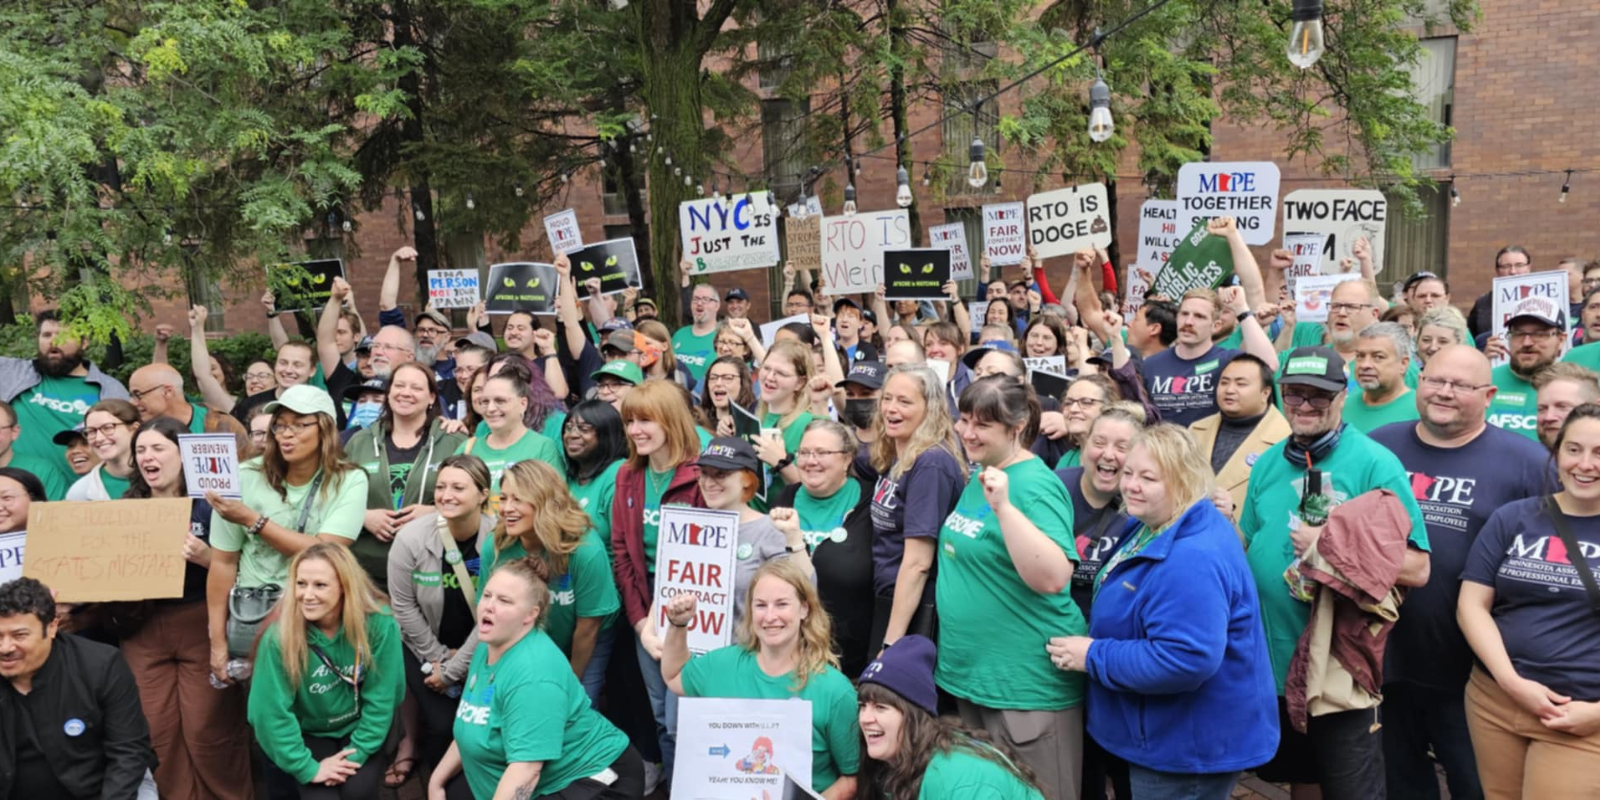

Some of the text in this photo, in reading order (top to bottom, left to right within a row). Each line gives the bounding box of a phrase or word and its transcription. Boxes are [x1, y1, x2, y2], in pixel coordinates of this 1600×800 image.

[1029, 194, 1099, 224] RTO IS
[1182, 196, 1272, 210] TOGETHER
[1284, 199, 1386, 221] TWO FACE
[688, 198, 750, 231] NYC
[827, 215, 908, 252] RTO IS
[990, 224, 1018, 237] FAIR
[1031, 219, 1089, 245] DOGE
[988, 244, 1021, 257] NOW
[430, 277, 477, 289] PERSON
[191, 443, 229, 454] MEMBER
[198, 477, 231, 489] PROUD
[1425, 514, 1467, 528] EMPLOYEES
[1508, 559, 1554, 572] MINNESOTA
[667, 559, 722, 588] FAIR
[1506, 568, 1570, 585] PROFESSIONAL
[730, 776, 743, 784] YOU
